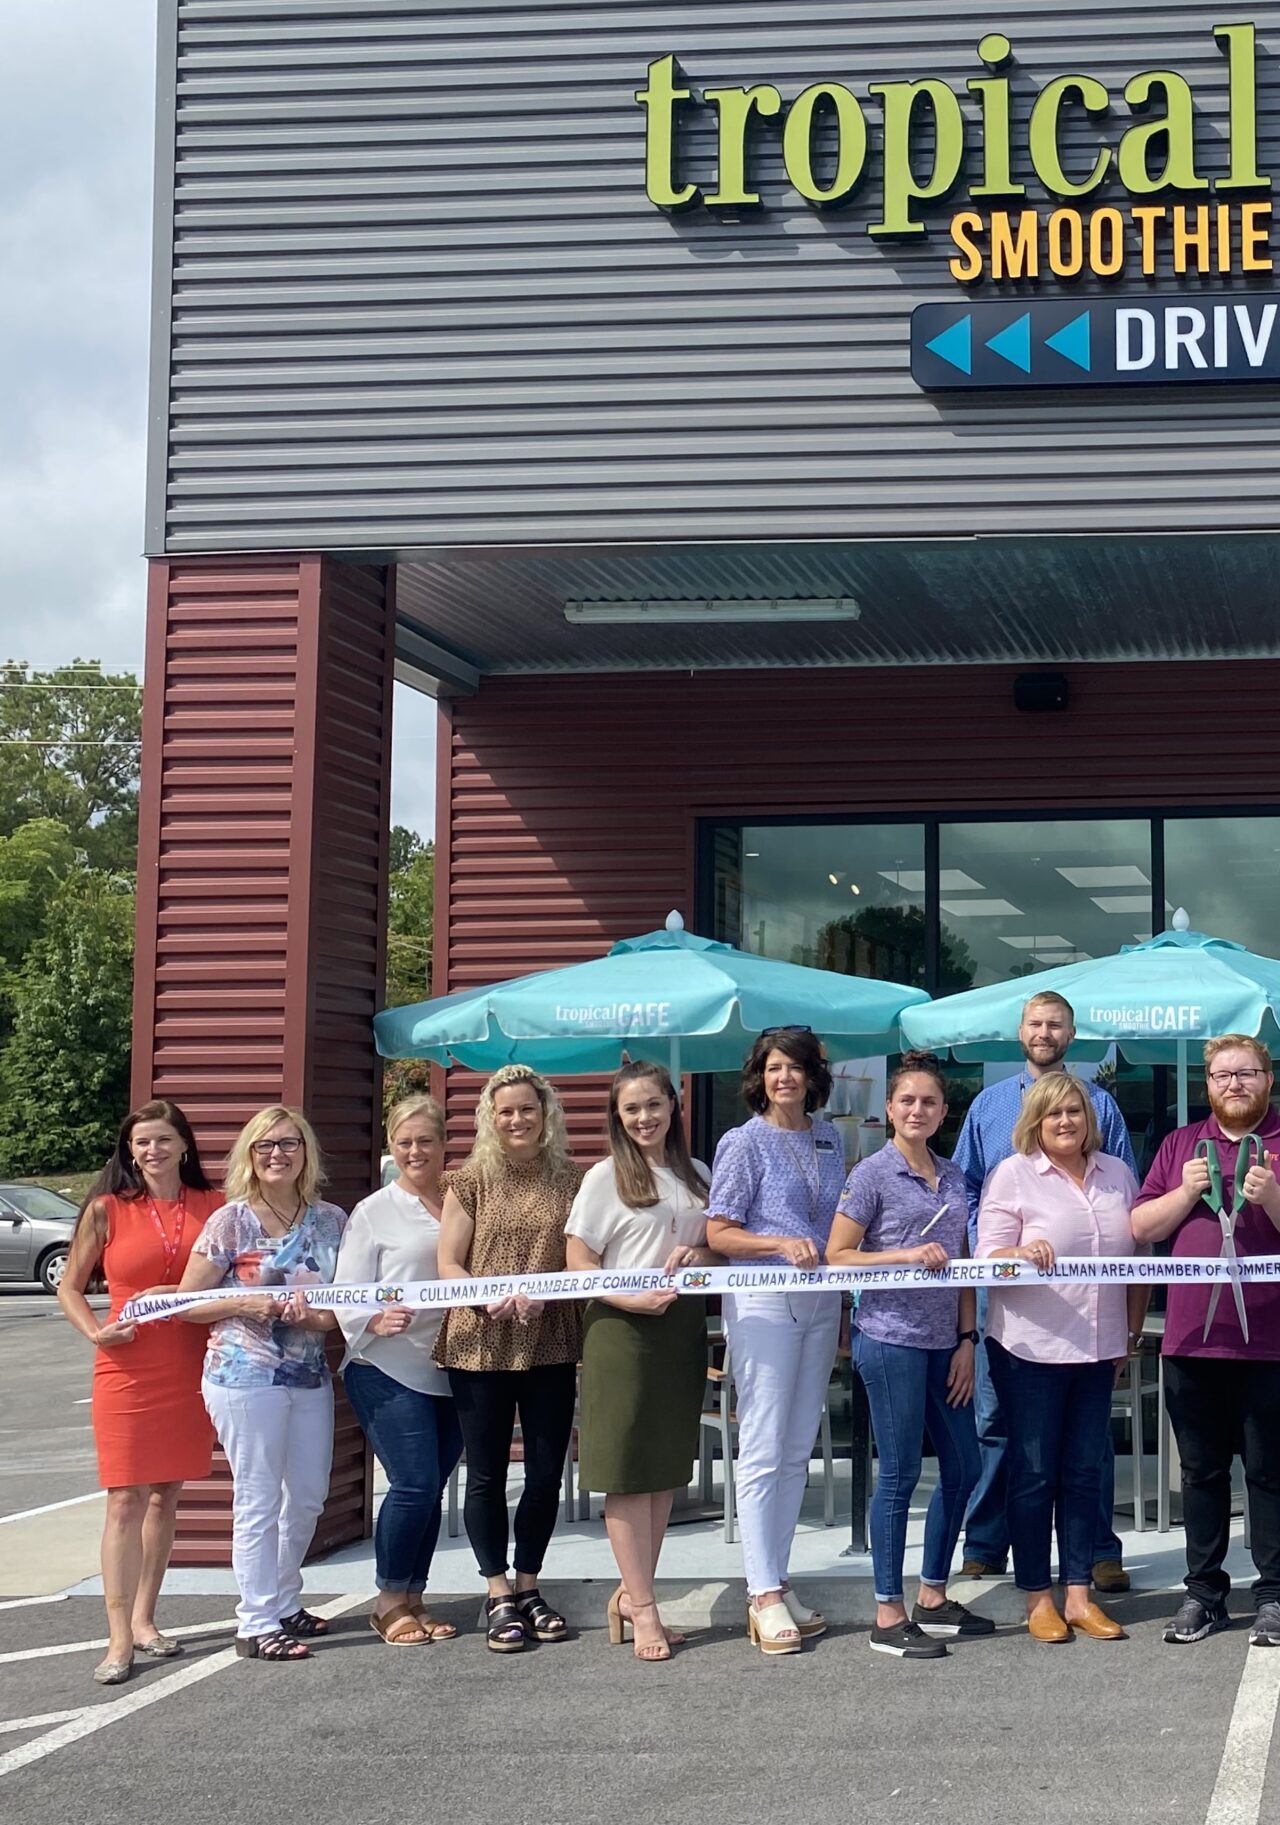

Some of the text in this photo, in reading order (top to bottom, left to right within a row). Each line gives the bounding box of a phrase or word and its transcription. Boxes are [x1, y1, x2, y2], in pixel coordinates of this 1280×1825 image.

[635, 22, 1272, 237] tropical
[948, 202, 1273, 282] SMOOTHIE
[556, 1002, 671, 1027] tropical CAFE
[1089, 1005, 1202, 1030] tropical CAFE
[305, 1289, 368, 1305] OMMERCE
[420, 1287, 478, 1302] CULLMAN
[482, 1282, 513, 1298] AREA
[518, 1277, 578, 1295] CHAMBER
[582, 1276, 598, 1291] OF
[602, 1274, 675, 1290] COMMERCE
[728, 1272, 787, 1288] CULLMAN
[790, 1271, 823, 1286] AREA
[828, 1269, 889, 1285] CHAMBER
[893, 1268, 910, 1282] OF
[914, 1265, 985, 1281] COMMERCE
[1101, 1263, 1135, 1277] AREA
[1138, 1262, 1201, 1277] CHAMBER
[1205, 1264, 1221, 1276] OF
